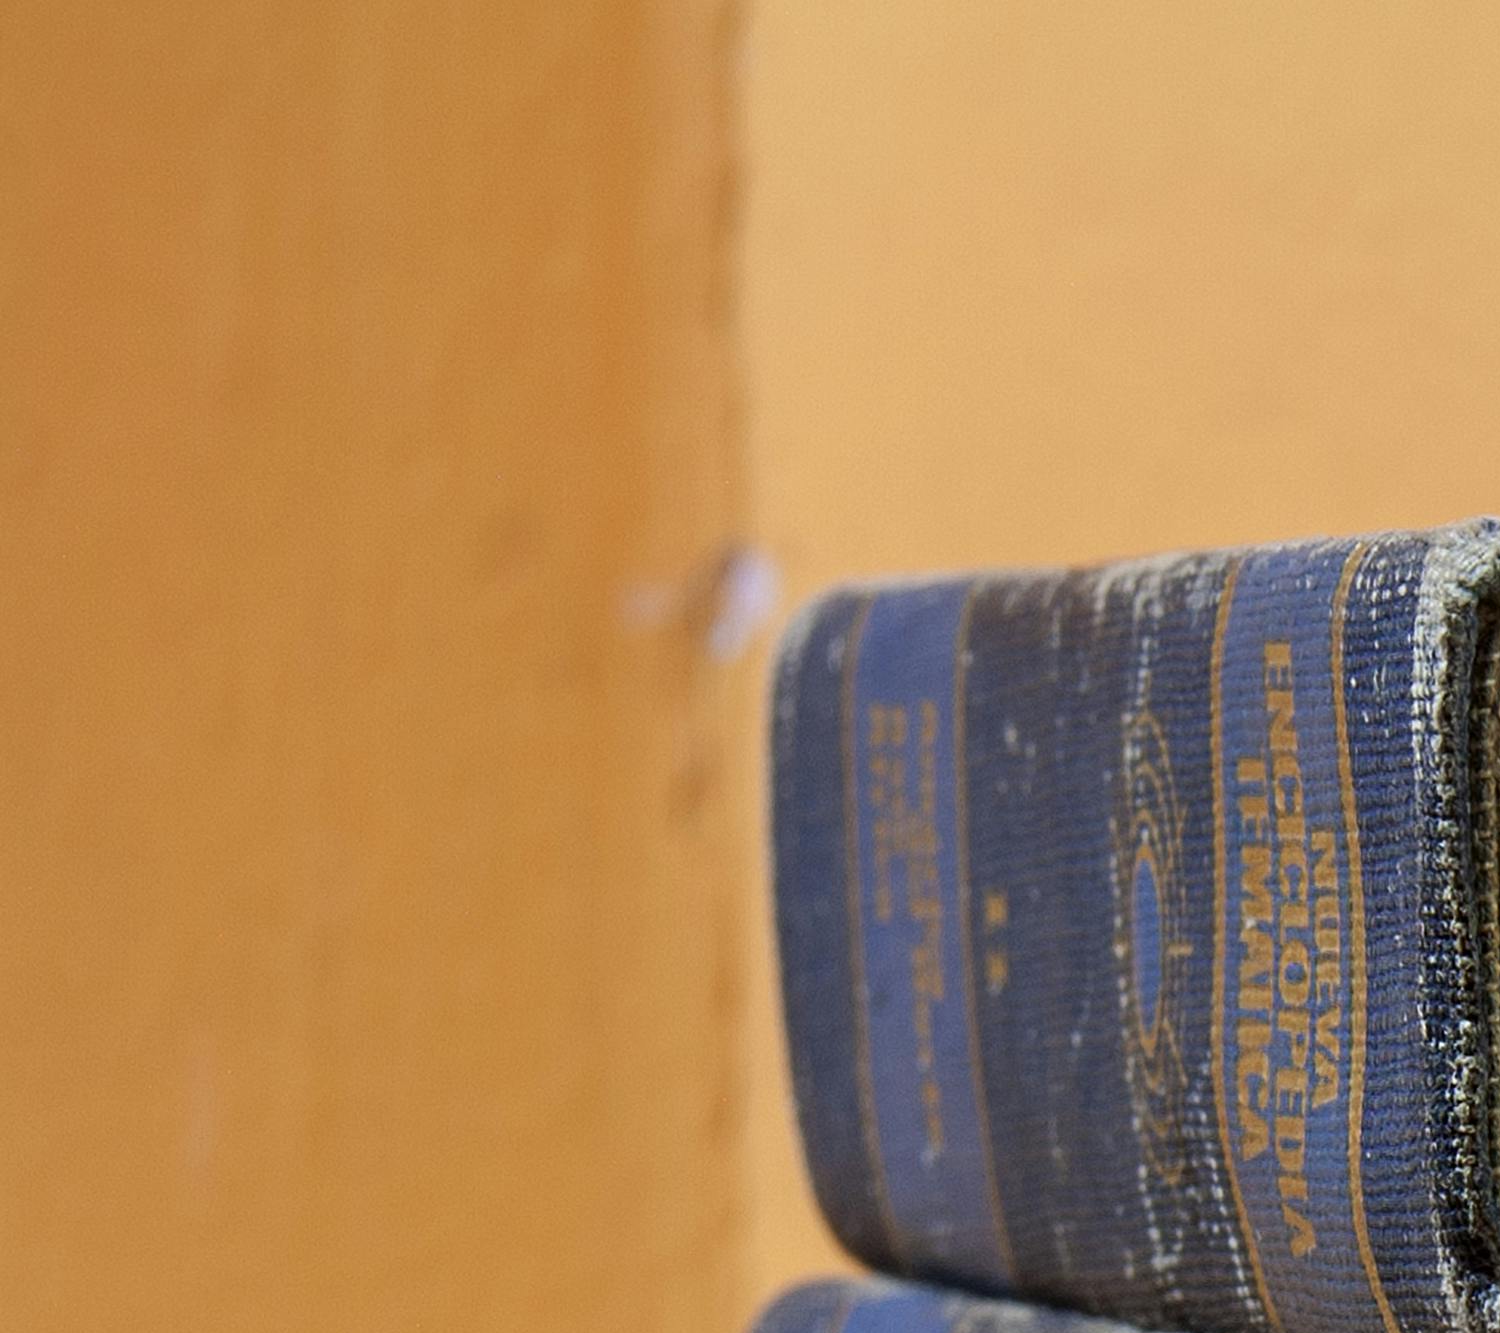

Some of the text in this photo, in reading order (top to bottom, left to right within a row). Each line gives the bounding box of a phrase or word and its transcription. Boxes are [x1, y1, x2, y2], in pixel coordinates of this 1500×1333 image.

[1235, 751, 1275, 1162] TEMATICA
[1263, 641, 1317, 1259] ENCICLOPEDIA
[1310, 828, 1341, 1109] NUEVA
